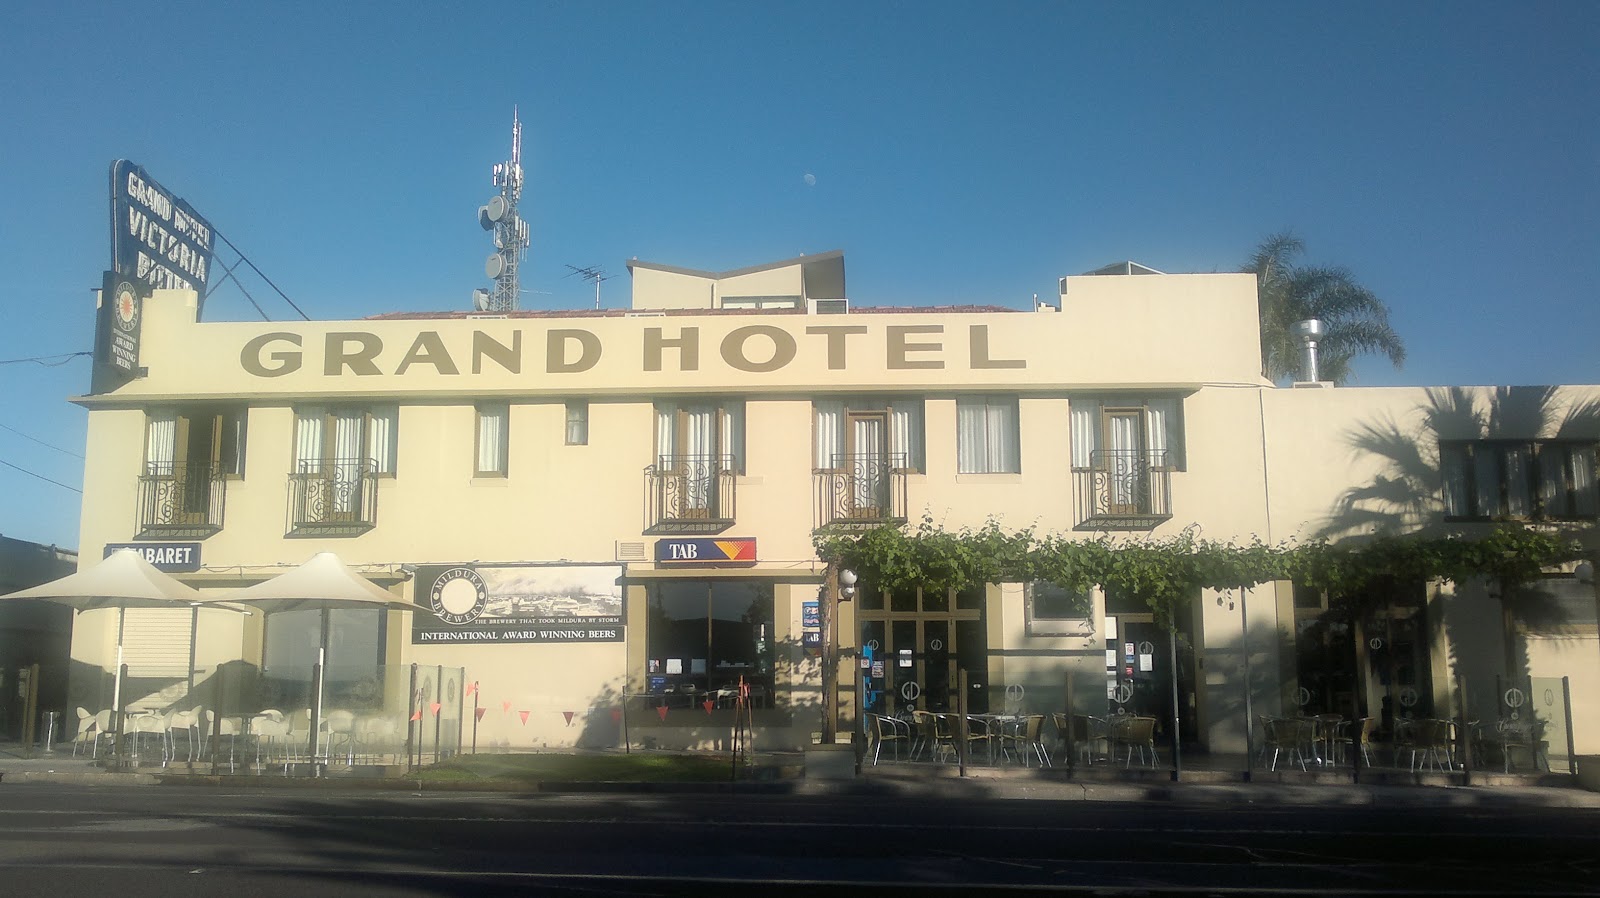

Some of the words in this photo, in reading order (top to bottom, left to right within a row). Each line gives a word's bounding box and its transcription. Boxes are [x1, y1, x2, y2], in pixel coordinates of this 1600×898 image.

[128, 171, 172, 222] GRAND
[129, 205, 206, 284] VICTORIA
[115, 337, 134, 351] AWARD
[240, 329, 602, 377] GRAND
[643, 325, 1027, 372] HOTEL
[112, 344, 136, 363] WINNING
[116, 356, 131, 370] BEERS
[129, 547, 192, 564] ABARET
[669, 543, 698, 559] TAB
[435, 570, 483, 590] MILDURA
[433, 601, 484, 623] BREWERY
[420, 631, 499, 641] INTERNATIONAL
[502, 630, 537, 640] AWARD
[540, 630, 586, 639] WINNING
[588, 629, 616, 639] BEERS
[805, 633, 820, 642] TAB
